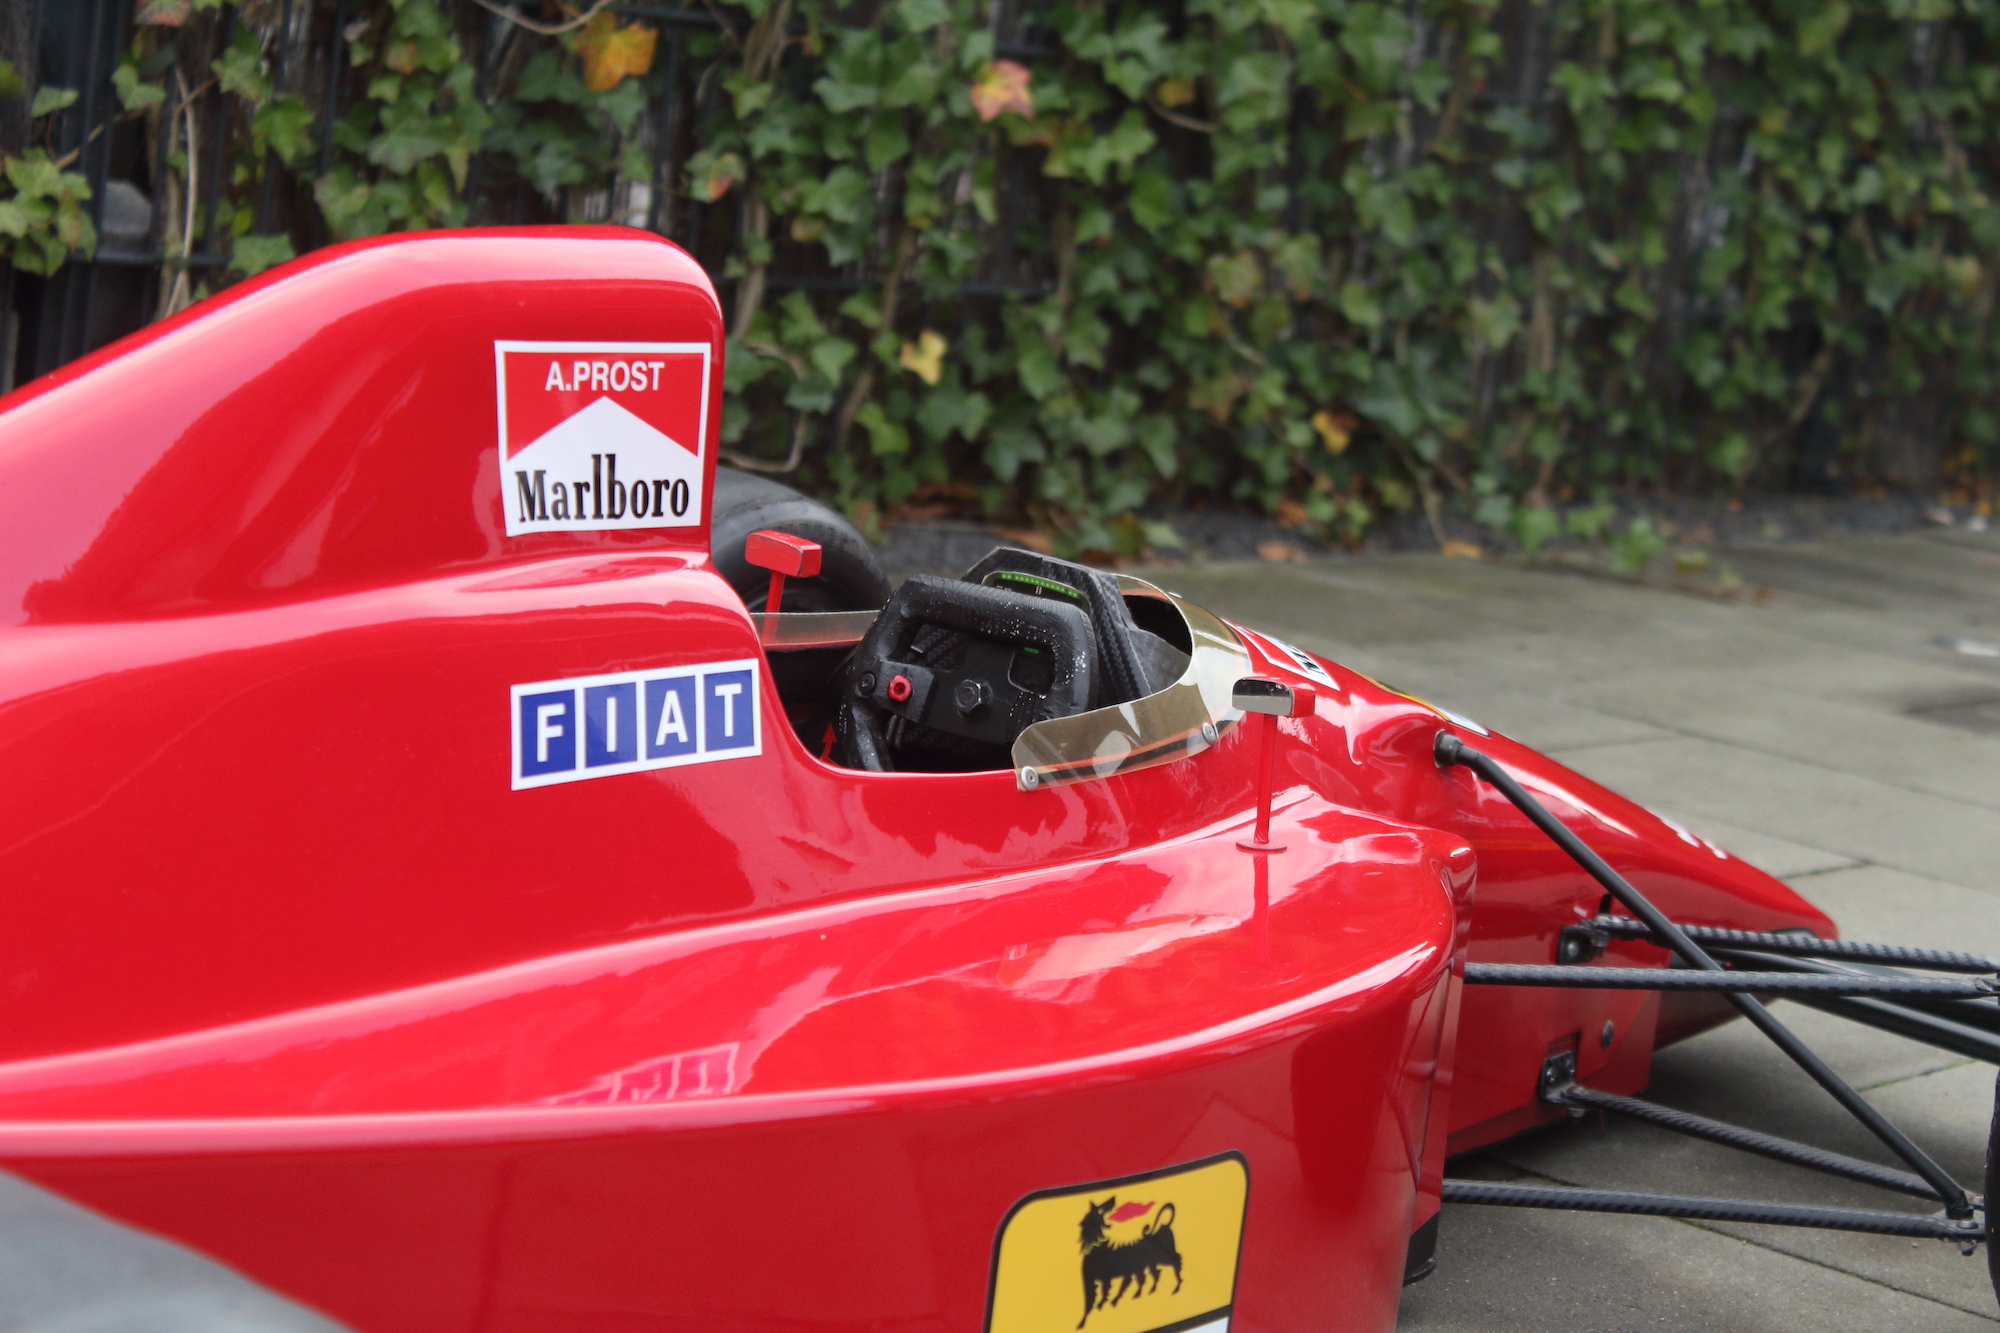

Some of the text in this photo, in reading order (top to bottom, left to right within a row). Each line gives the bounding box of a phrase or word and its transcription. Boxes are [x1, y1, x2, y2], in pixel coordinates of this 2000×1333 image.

[544, 360, 666, 392] A.PROST
[514, 453, 690, 523] Marlboro
[535, 681, 744, 764] FIAT
